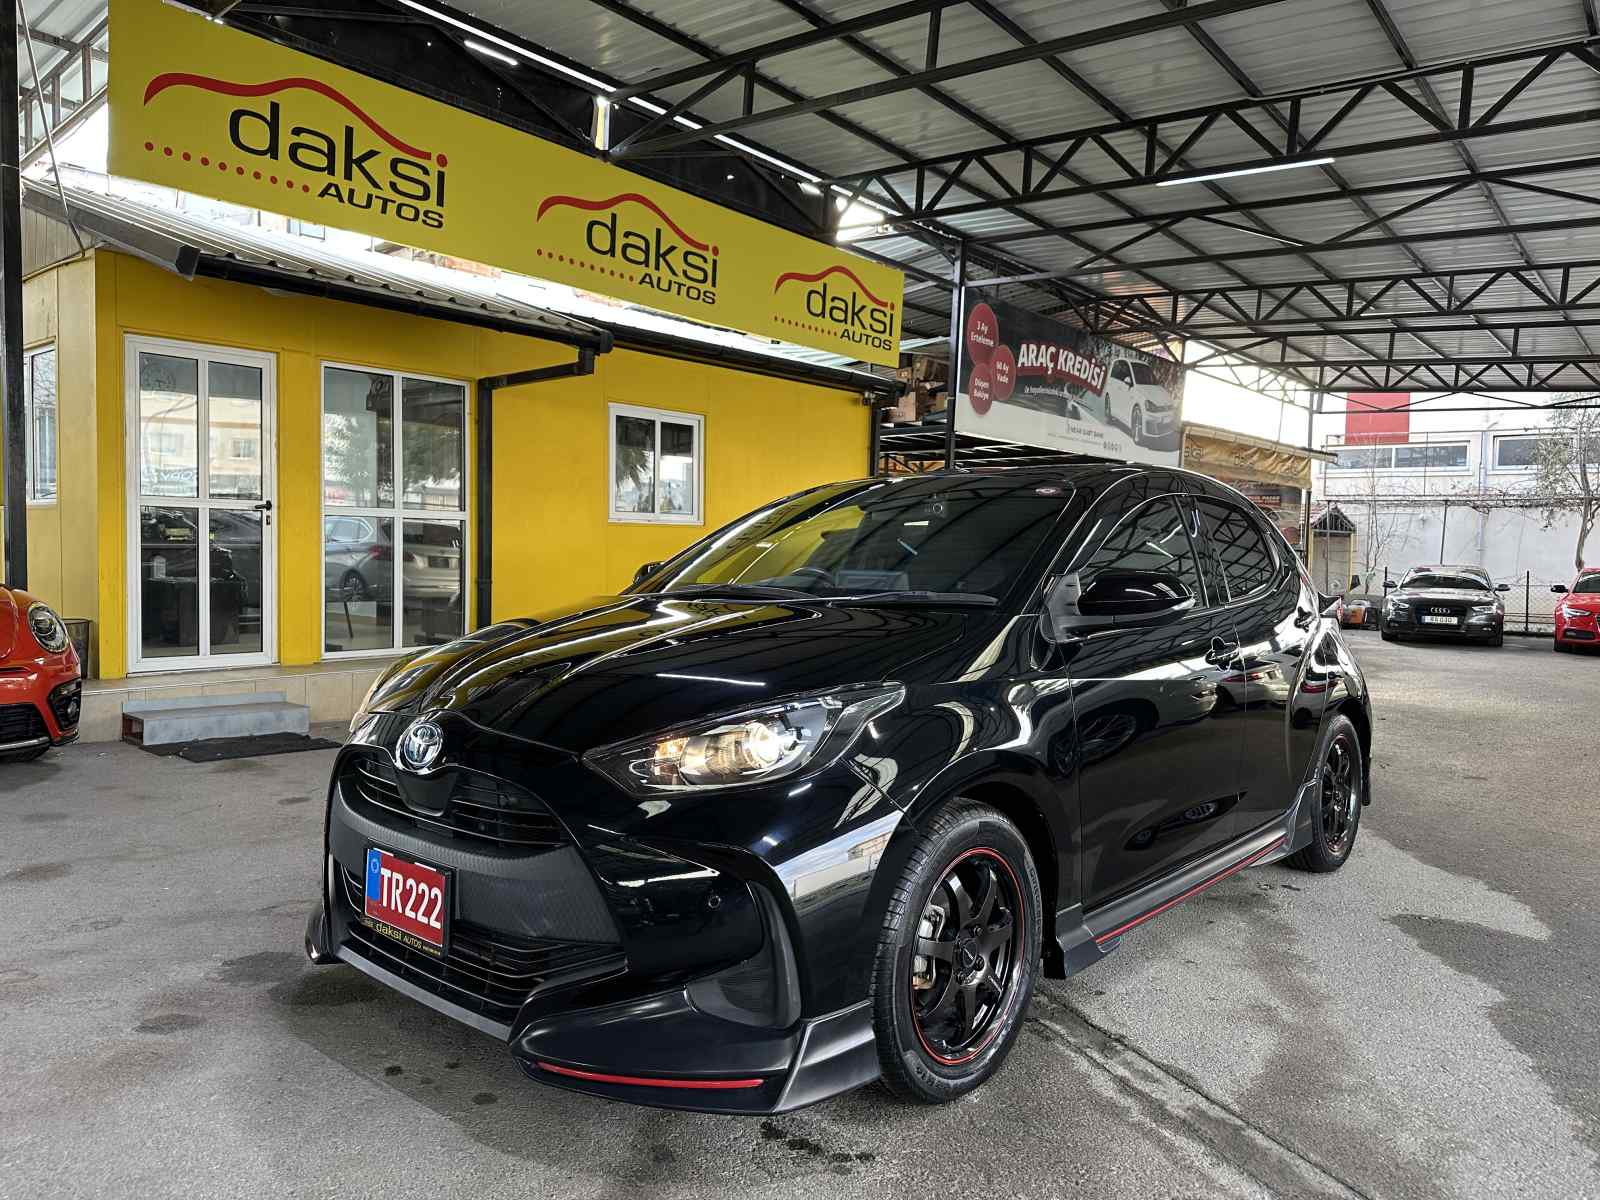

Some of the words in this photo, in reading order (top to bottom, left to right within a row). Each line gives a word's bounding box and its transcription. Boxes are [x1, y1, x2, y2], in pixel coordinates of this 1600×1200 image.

[229, 101, 448, 207] daksi
[318, 182, 444, 229] AUTOS
[586, 212, 719, 288] daksi
[638, 272, 716, 305] AUTOS
[806, 283, 895, 337] daksi
[839, 329, 892, 351] AUTOS
[1018, 343, 1057, 374] ARAÇ
[1057, 348, 1106, 389] KREDİSİ
[376, 922, 402, 940] daksi
[403, 935, 422, 949] AUTOS
